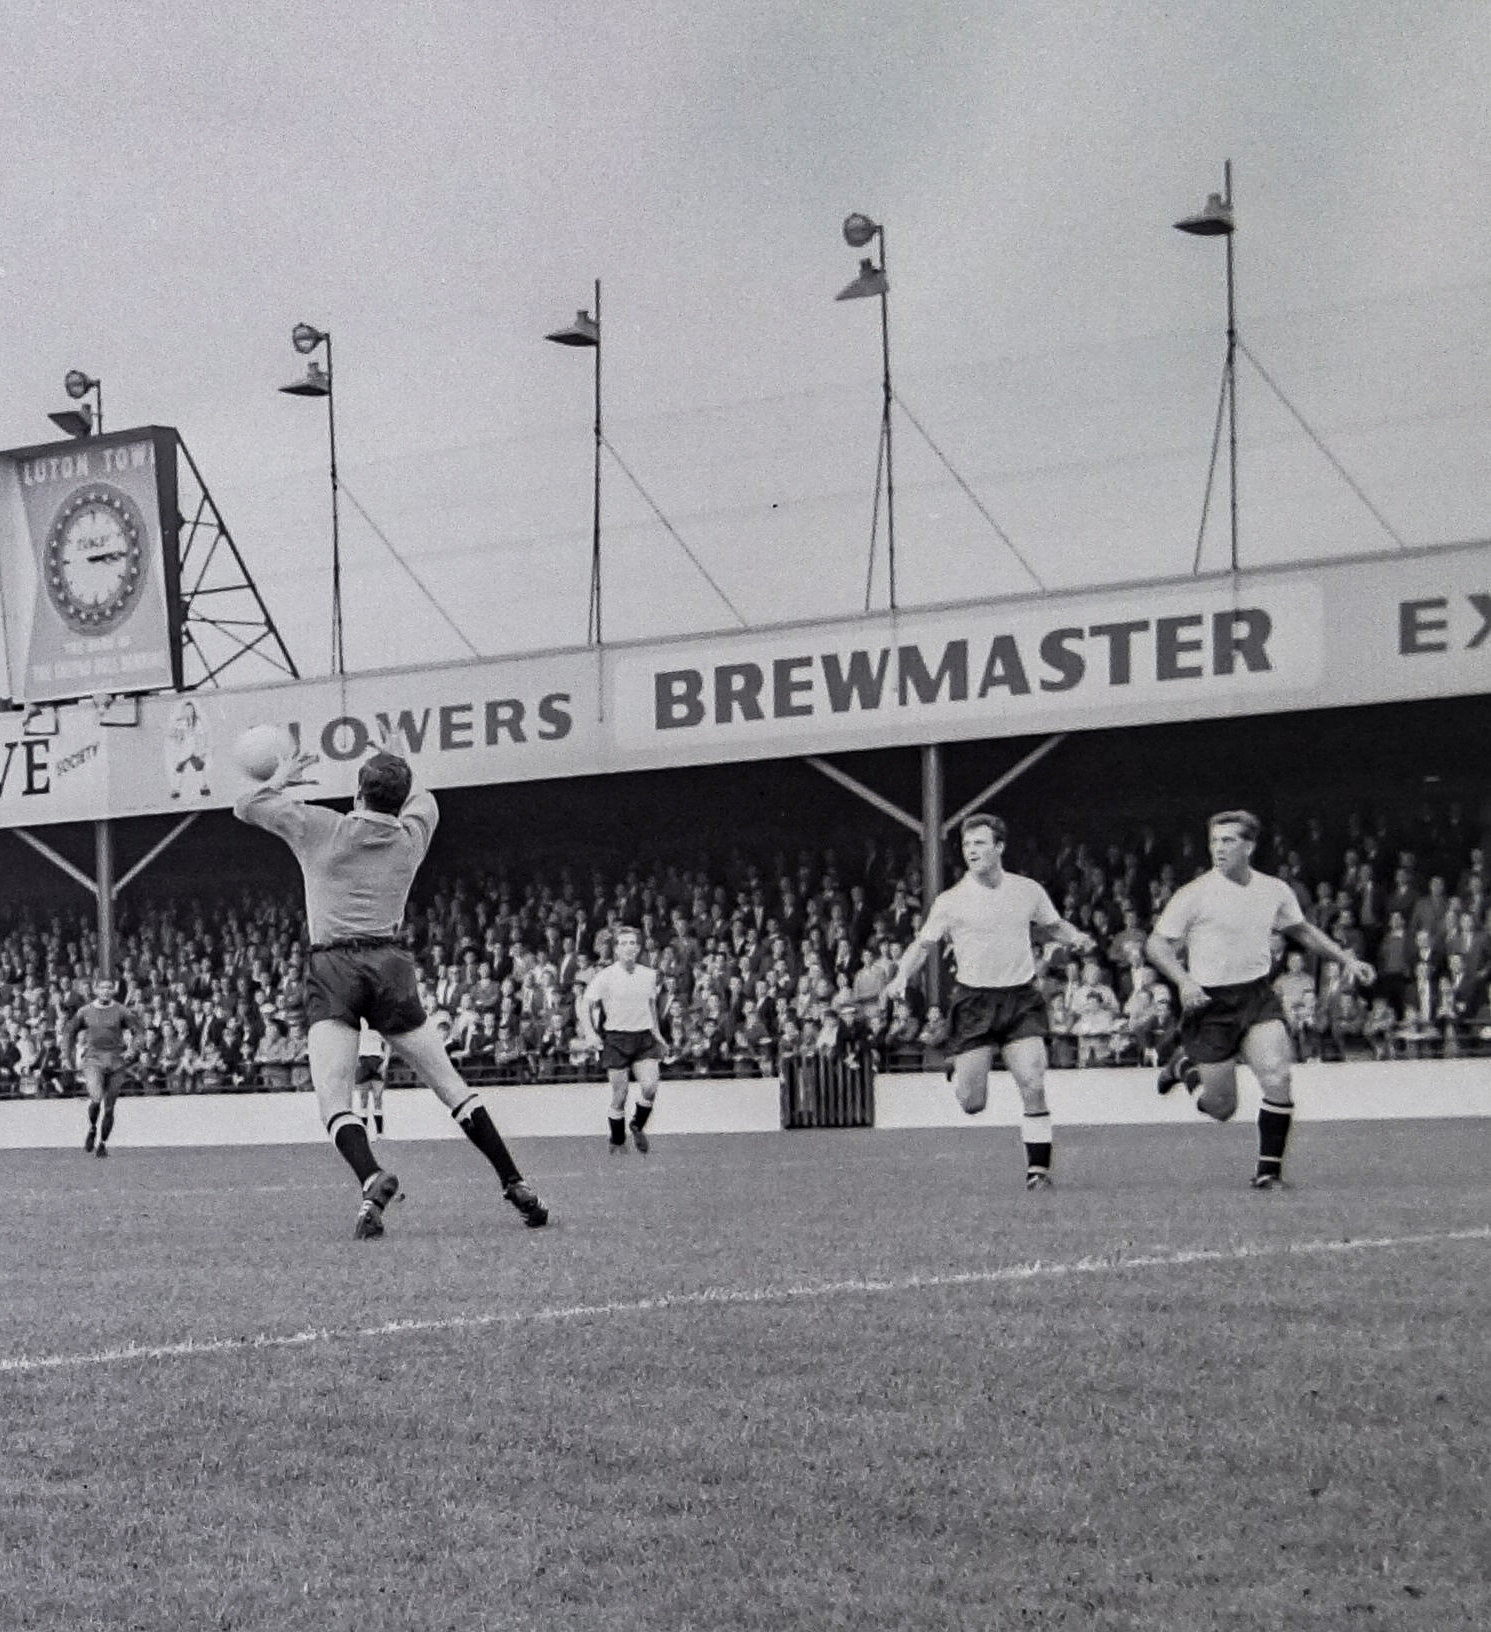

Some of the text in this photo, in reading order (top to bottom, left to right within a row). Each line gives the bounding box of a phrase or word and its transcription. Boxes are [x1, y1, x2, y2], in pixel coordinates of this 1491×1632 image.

[24, 451, 88, 486] LUTON
[654, 607, 1274, 731] BREWMASTER
[286, 693, 573, 762] LOWERS
